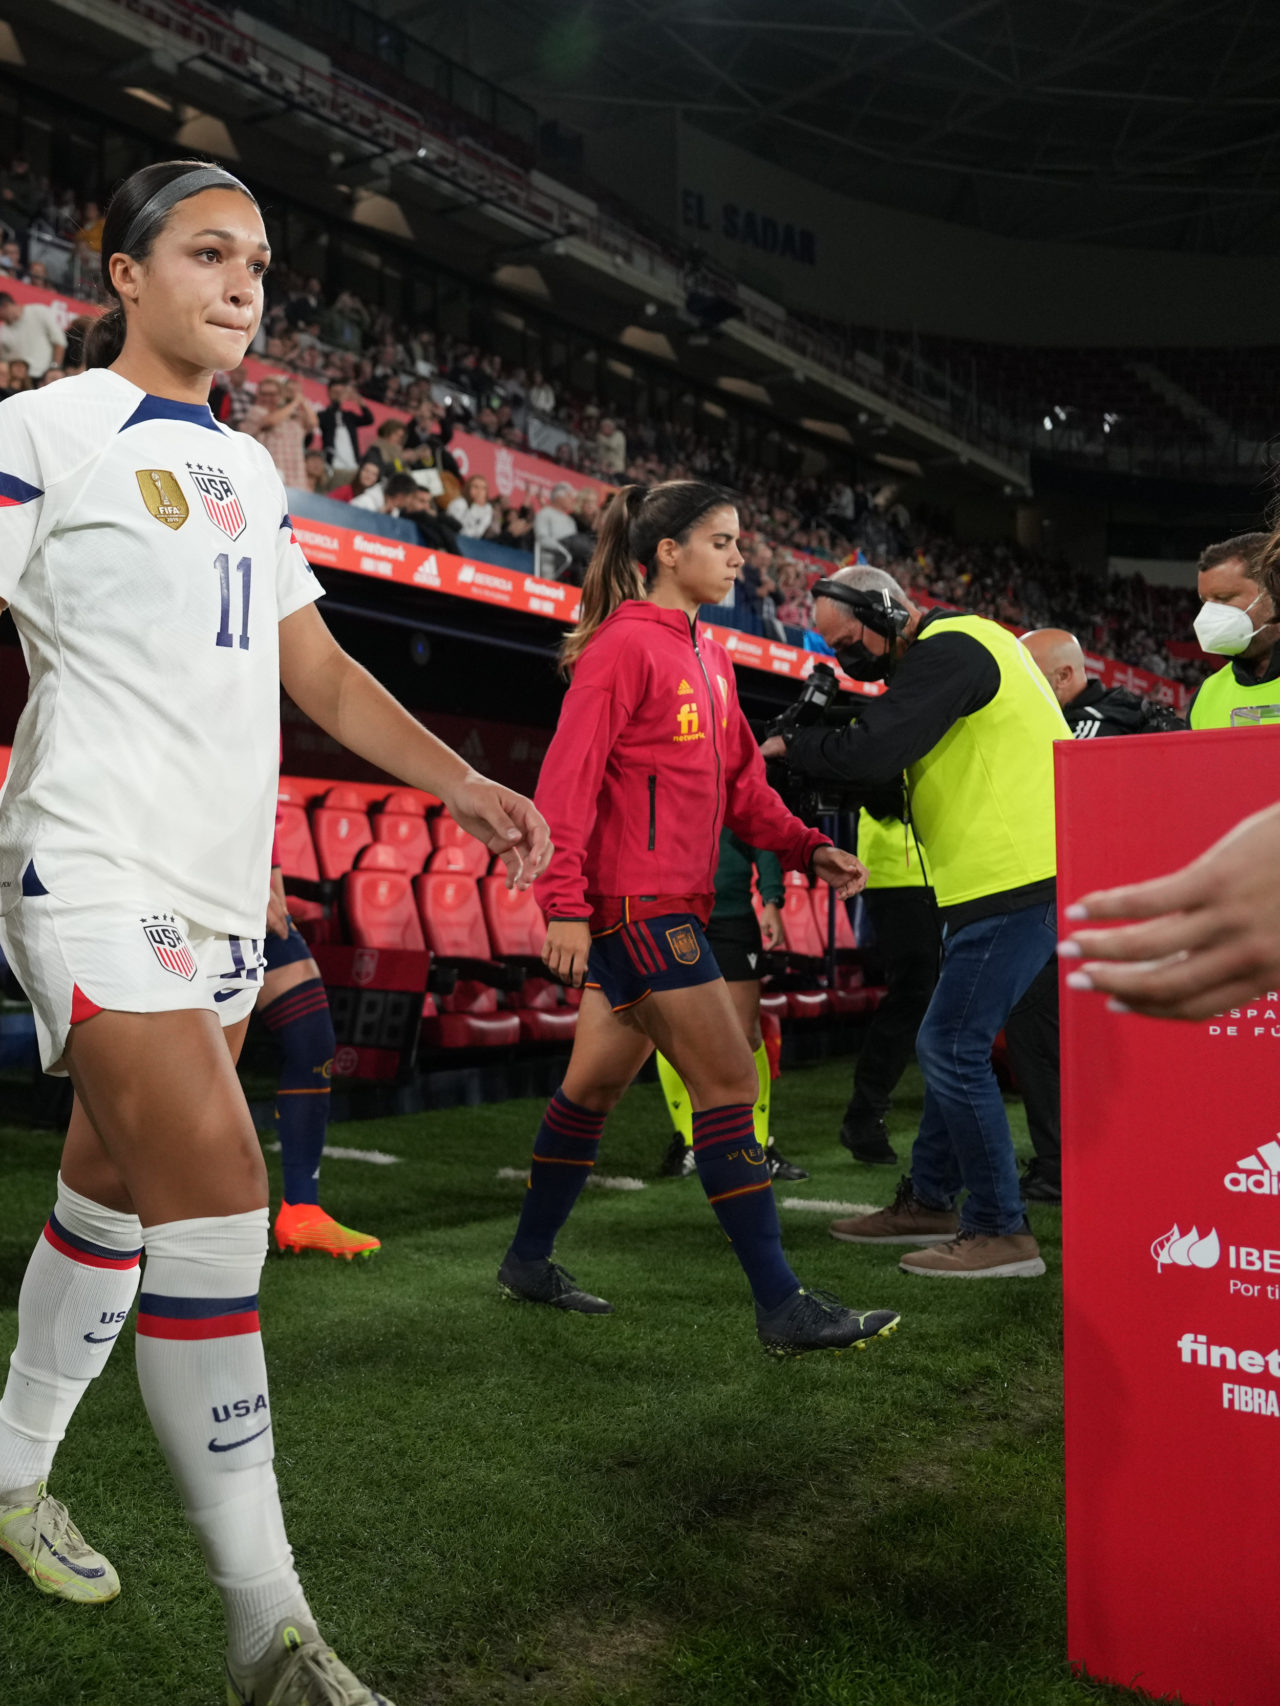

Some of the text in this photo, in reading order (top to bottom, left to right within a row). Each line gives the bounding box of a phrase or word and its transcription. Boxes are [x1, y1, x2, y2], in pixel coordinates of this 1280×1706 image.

[681, 187, 817, 265] EL SADAR
[195, 476, 233, 502] USA
[158, 506, 180, 515] FIFA
[214, 552, 251, 650] 11
[677, 703, 699, 734] fi
[673, 731, 706, 742] network
[149, 928, 183, 948] USA
[1208, 1025, 1238, 1036] DE
[1228, 1245, 1280, 1275] IBE
[1230, 1279, 1261, 1297] Por
[99, 1311, 126, 1325] US
[1177, 1333, 1280, 1378] finet
[211, 1394, 268, 1424] USA
[1222, 1382, 1280, 1418] FIBRA
